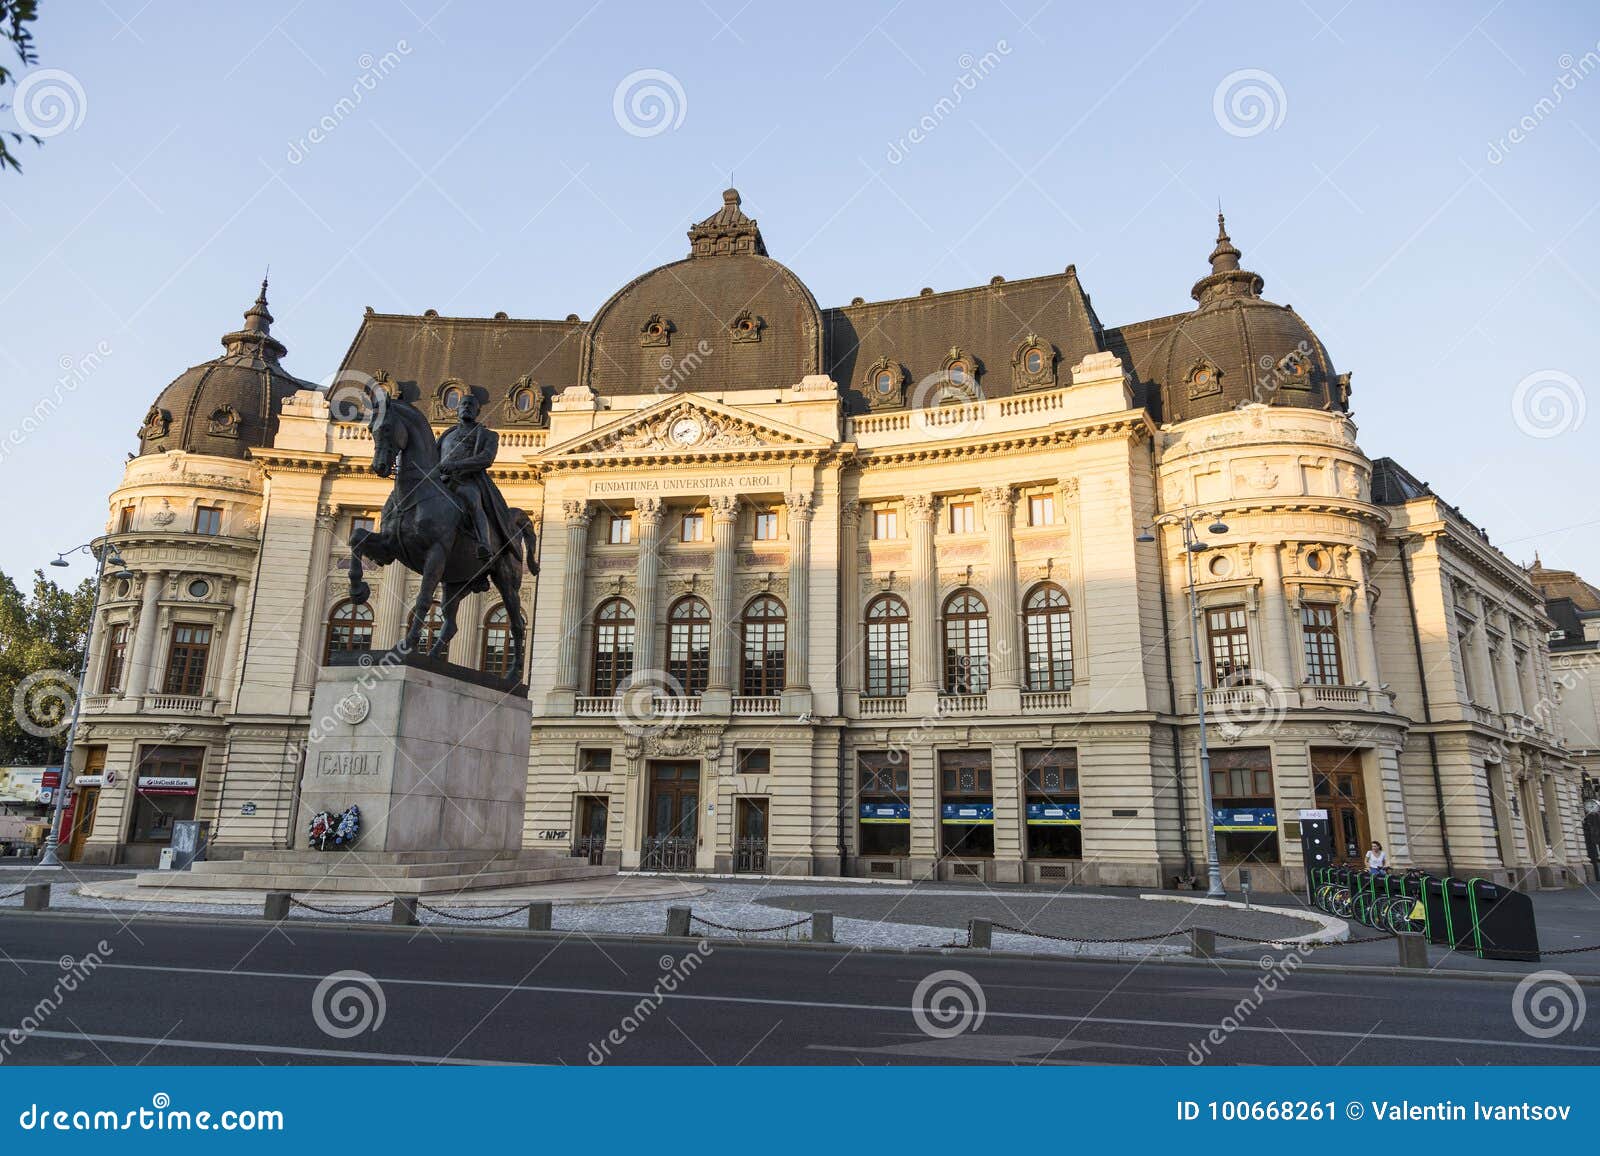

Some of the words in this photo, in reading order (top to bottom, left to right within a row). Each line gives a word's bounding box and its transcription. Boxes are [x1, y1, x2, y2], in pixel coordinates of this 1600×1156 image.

[594, 480, 660, 493] FUNDATIUNEA
[739, 474, 772, 487] CAROL
[321, 754, 369, 776] CAROL
